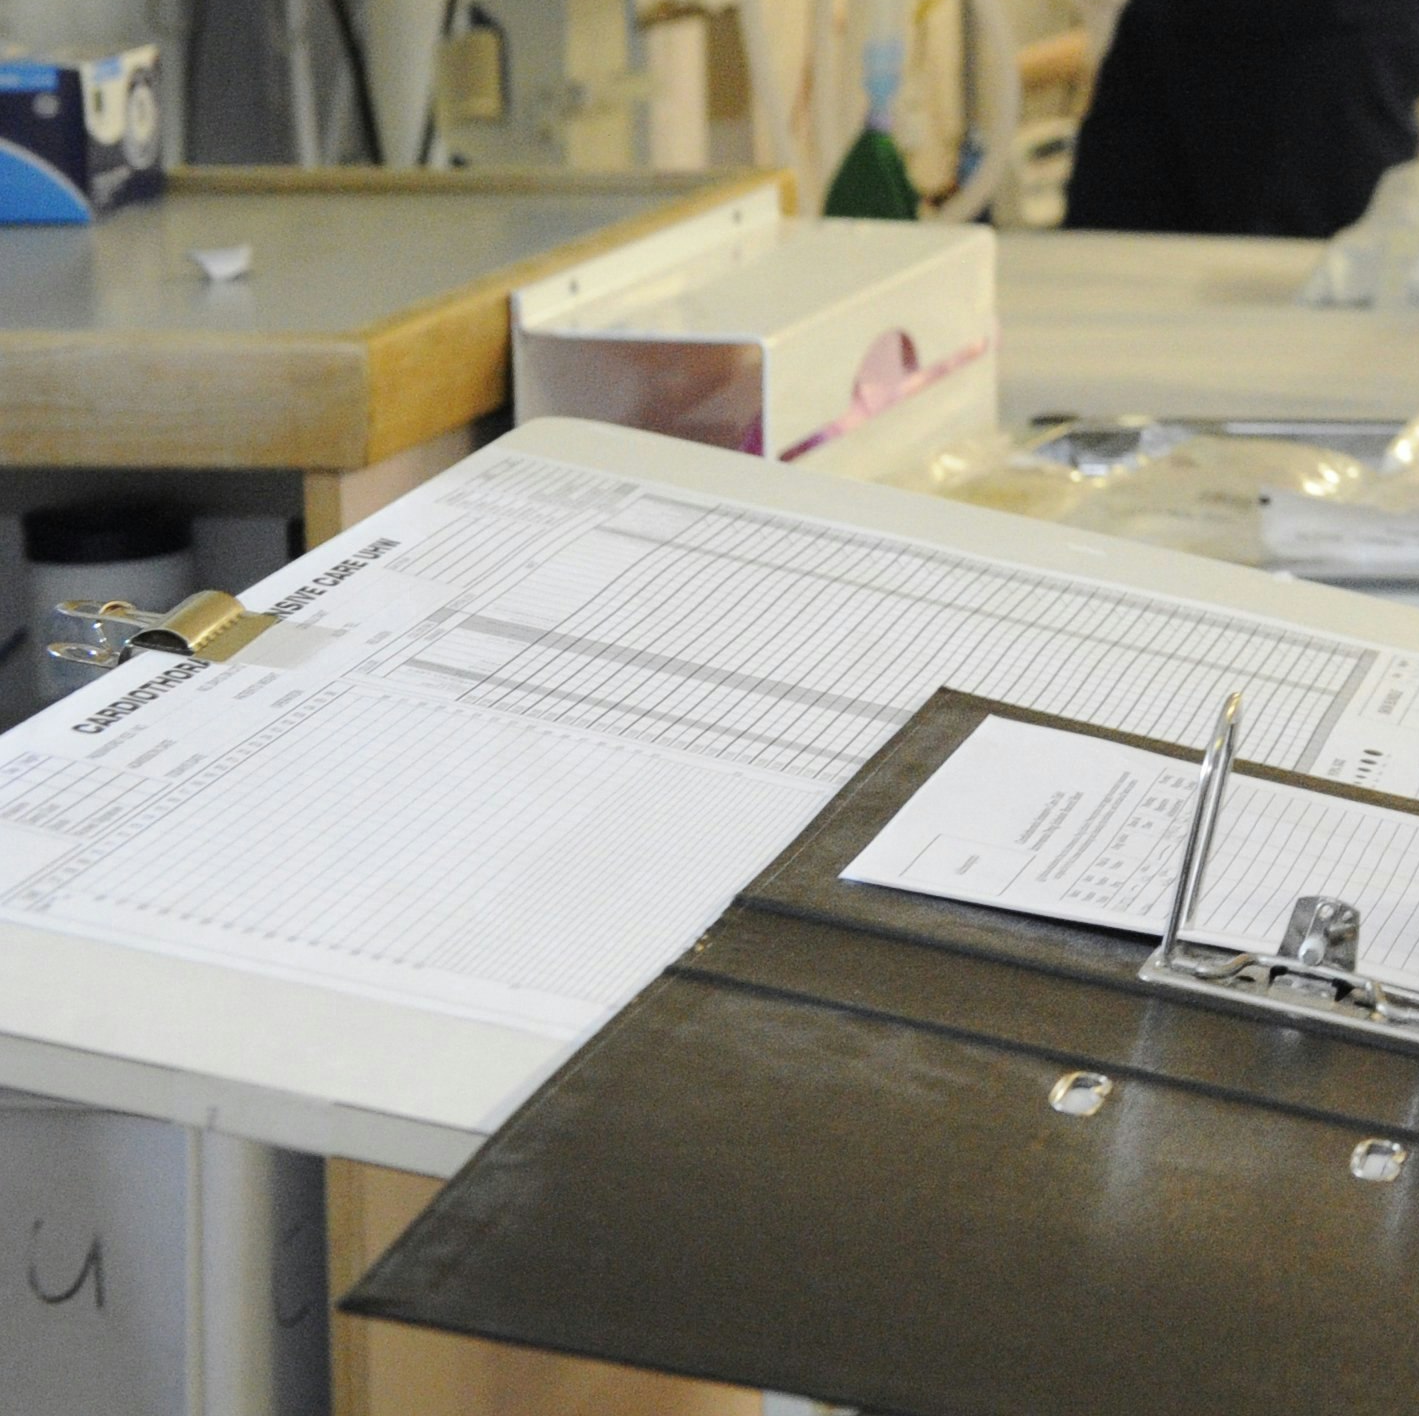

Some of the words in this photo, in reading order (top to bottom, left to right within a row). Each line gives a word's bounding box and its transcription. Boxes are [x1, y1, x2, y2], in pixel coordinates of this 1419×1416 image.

[72, 658, 211, 735] CARDIOTHORA
[312, 558, 368, 588] CARE
[352, 537, 402, 561] UHW
